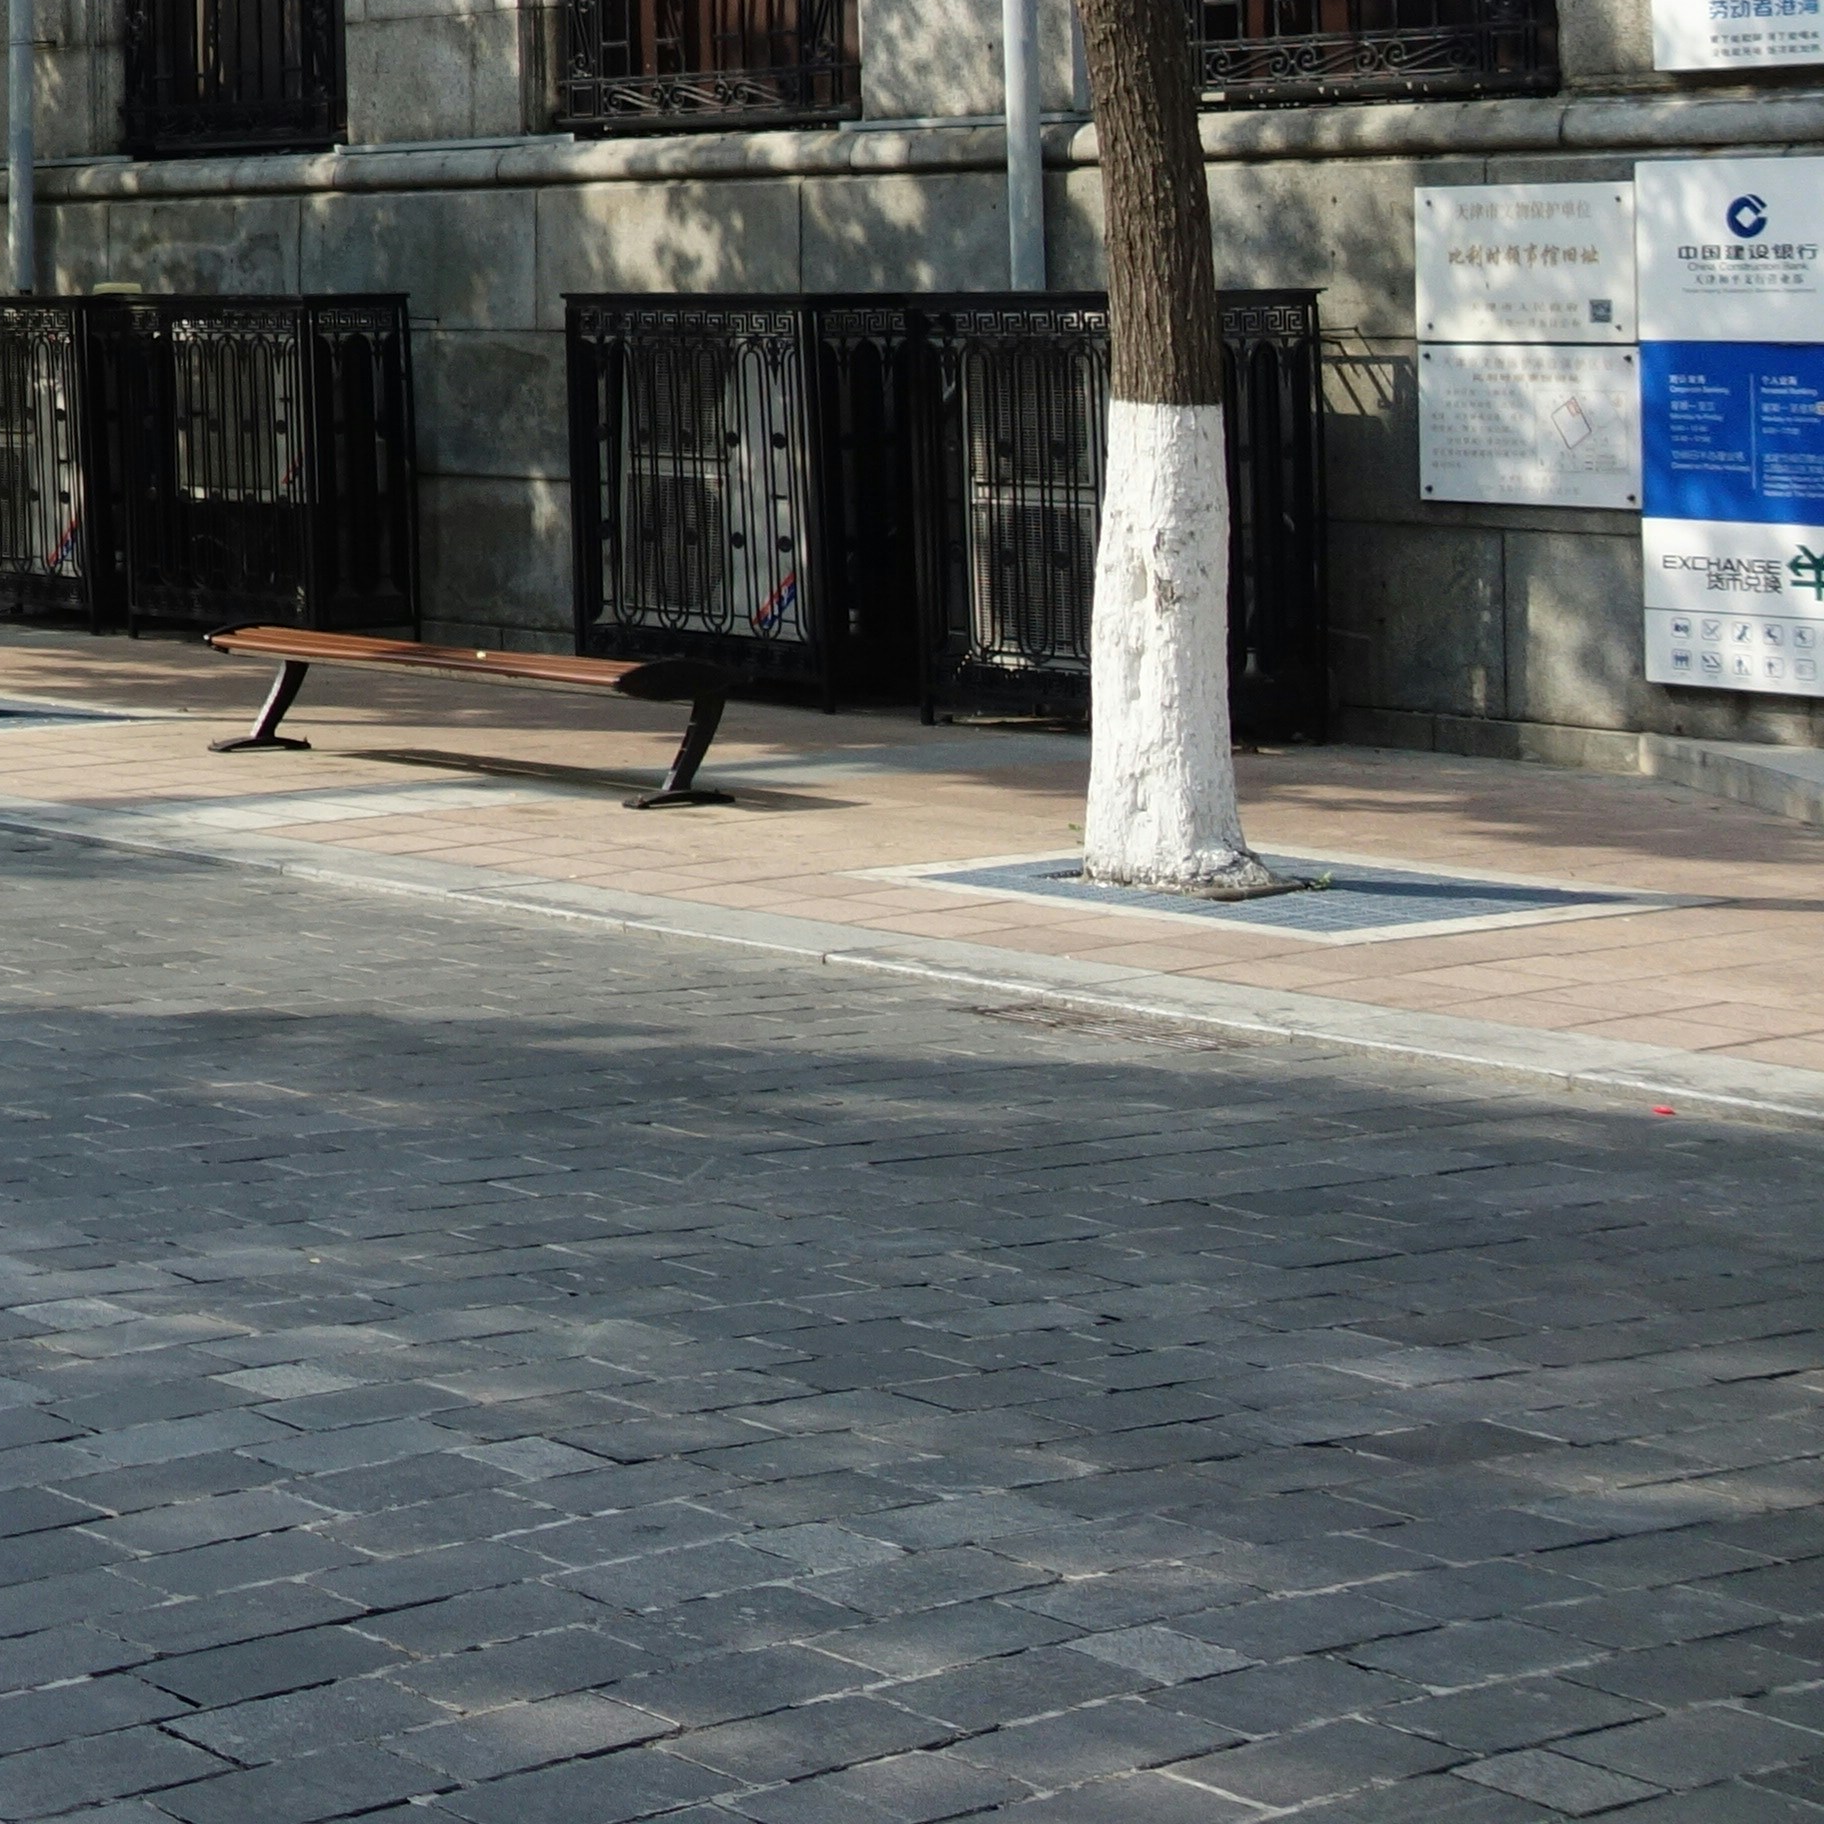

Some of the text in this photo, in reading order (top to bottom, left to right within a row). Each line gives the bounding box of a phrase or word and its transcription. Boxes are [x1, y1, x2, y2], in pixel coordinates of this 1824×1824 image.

[1456, 200, 1593, 220] 天津市文物保护单位
[1448, 242, 1601, 268] 比利时领事馆旧址
[1677, 243, 1818, 261] 中国建设银行
[1662, 555, 1781, 575] EXCHANGE
[1706, 573, 1783, 594] 货币兑换
